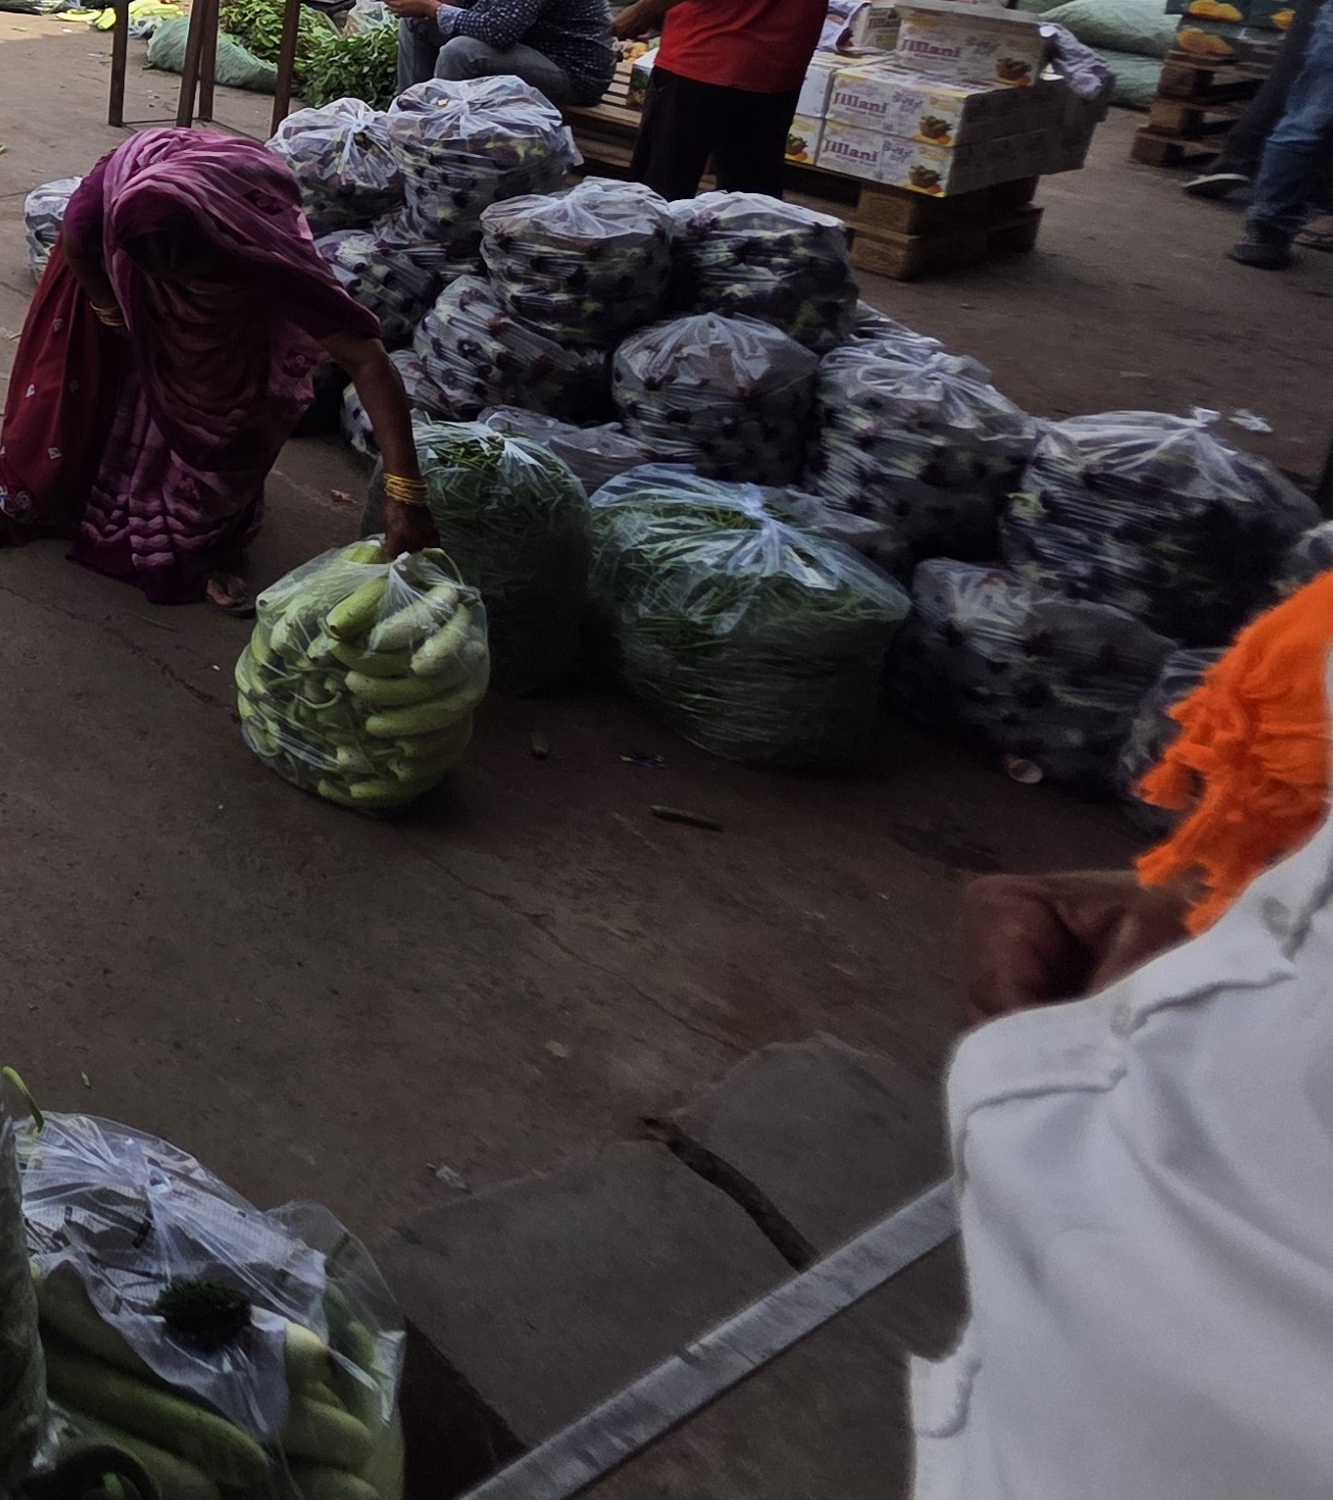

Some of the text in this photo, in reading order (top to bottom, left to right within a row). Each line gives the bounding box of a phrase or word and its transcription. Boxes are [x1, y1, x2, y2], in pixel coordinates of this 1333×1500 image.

[900, 38, 962, 58] Jillani
[832, 91, 889, 115] Jillani
[822, 139, 879, 163] Jillani
